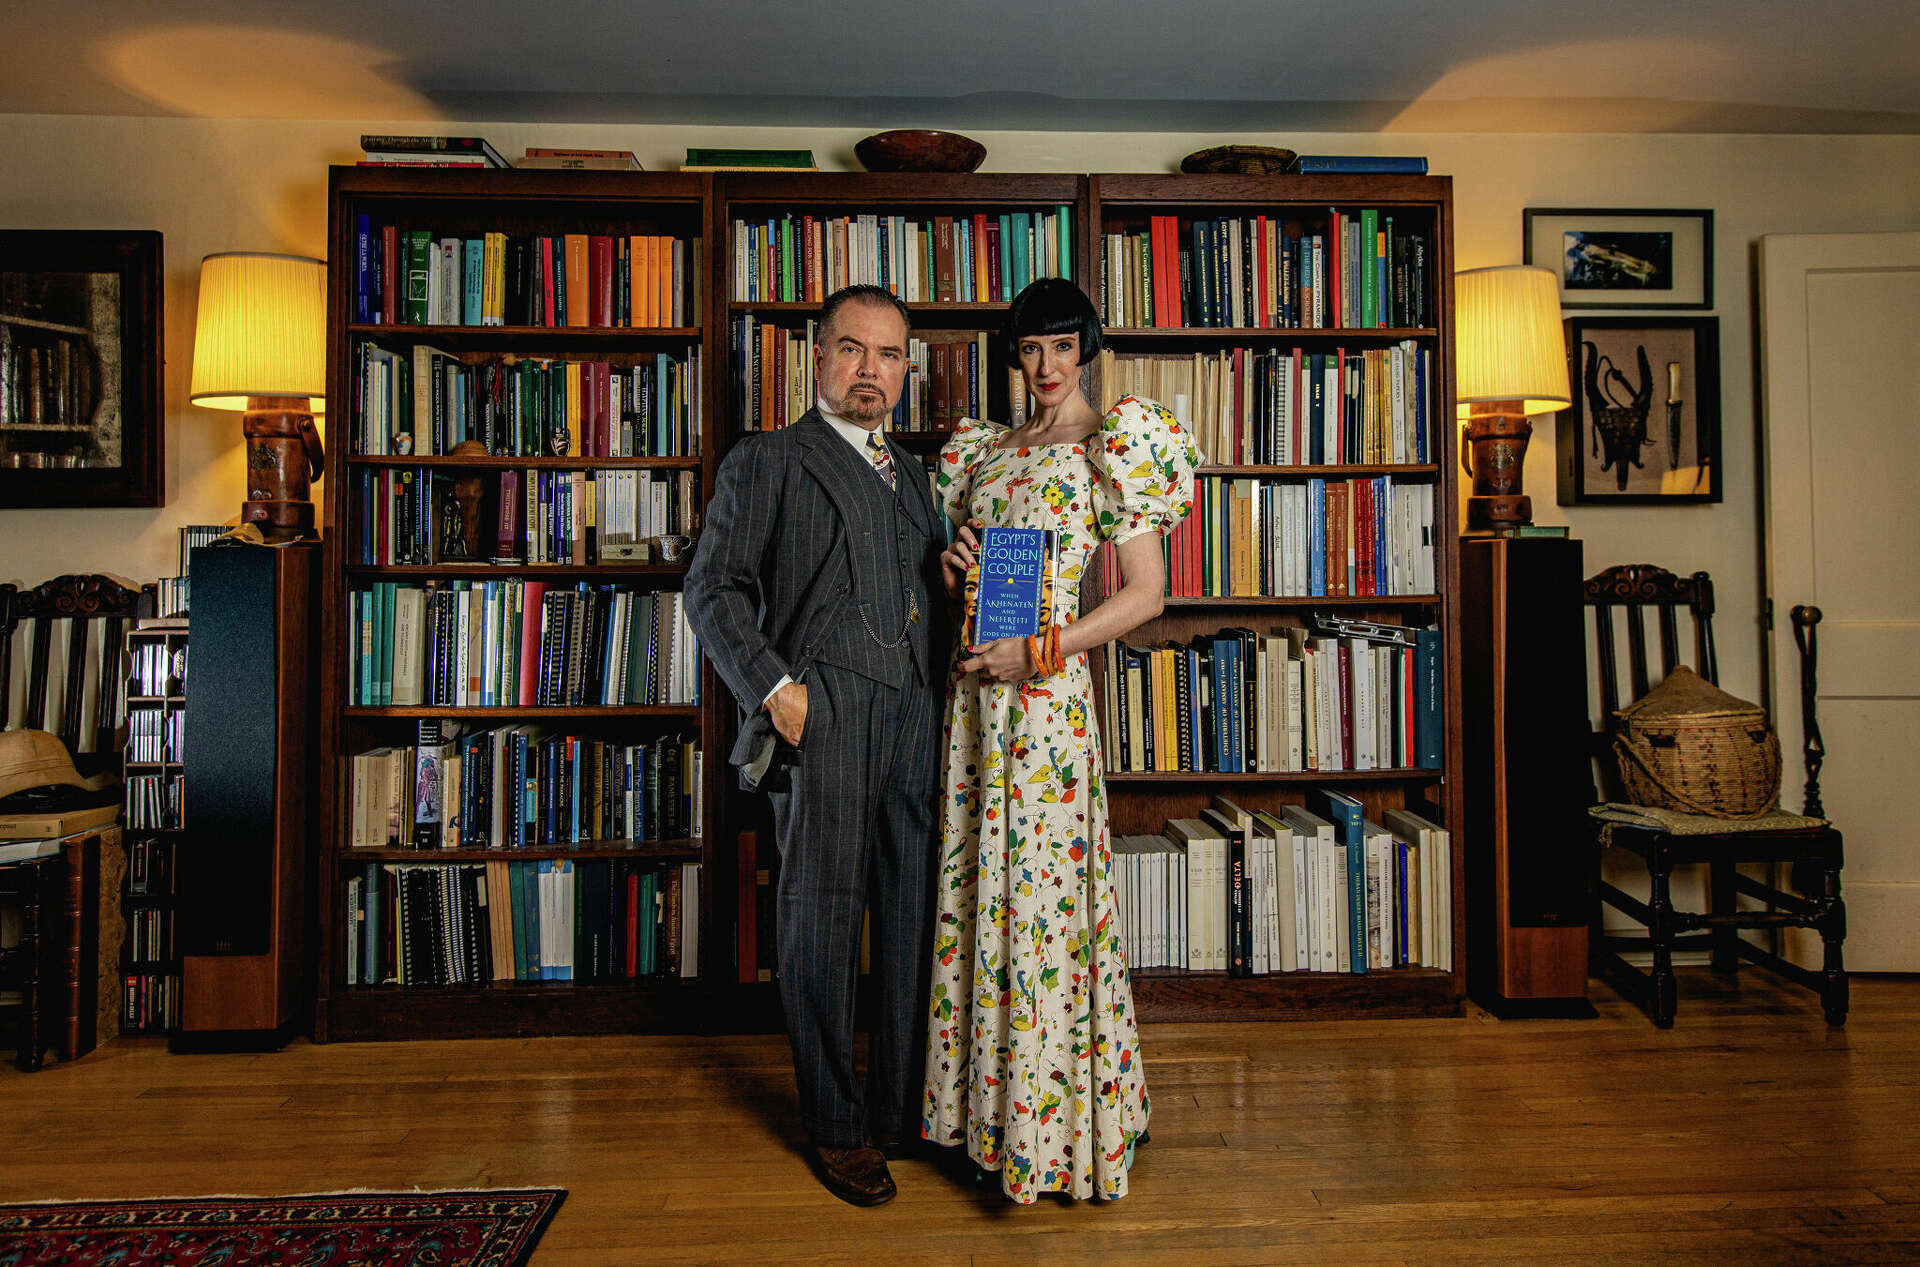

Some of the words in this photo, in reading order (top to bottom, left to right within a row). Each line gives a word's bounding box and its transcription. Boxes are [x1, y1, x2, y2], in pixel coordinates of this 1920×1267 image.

[1014, 371, 1023, 416] YRAMIDS
[991, 532, 1036, 546] EGYPT'S
[987, 548, 1038, 563] GOLDEN
[987, 563, 1035, 576] COUPLE
[985, 598, 1034, 609] AKHENATEN
[988, 615, 1028, 625] NEFERTITI
[668, 776, 676, 817] RAMESSES
[1234, 861, 1242, 889] DELTA
[668, 938, 676, 955] Egypt
